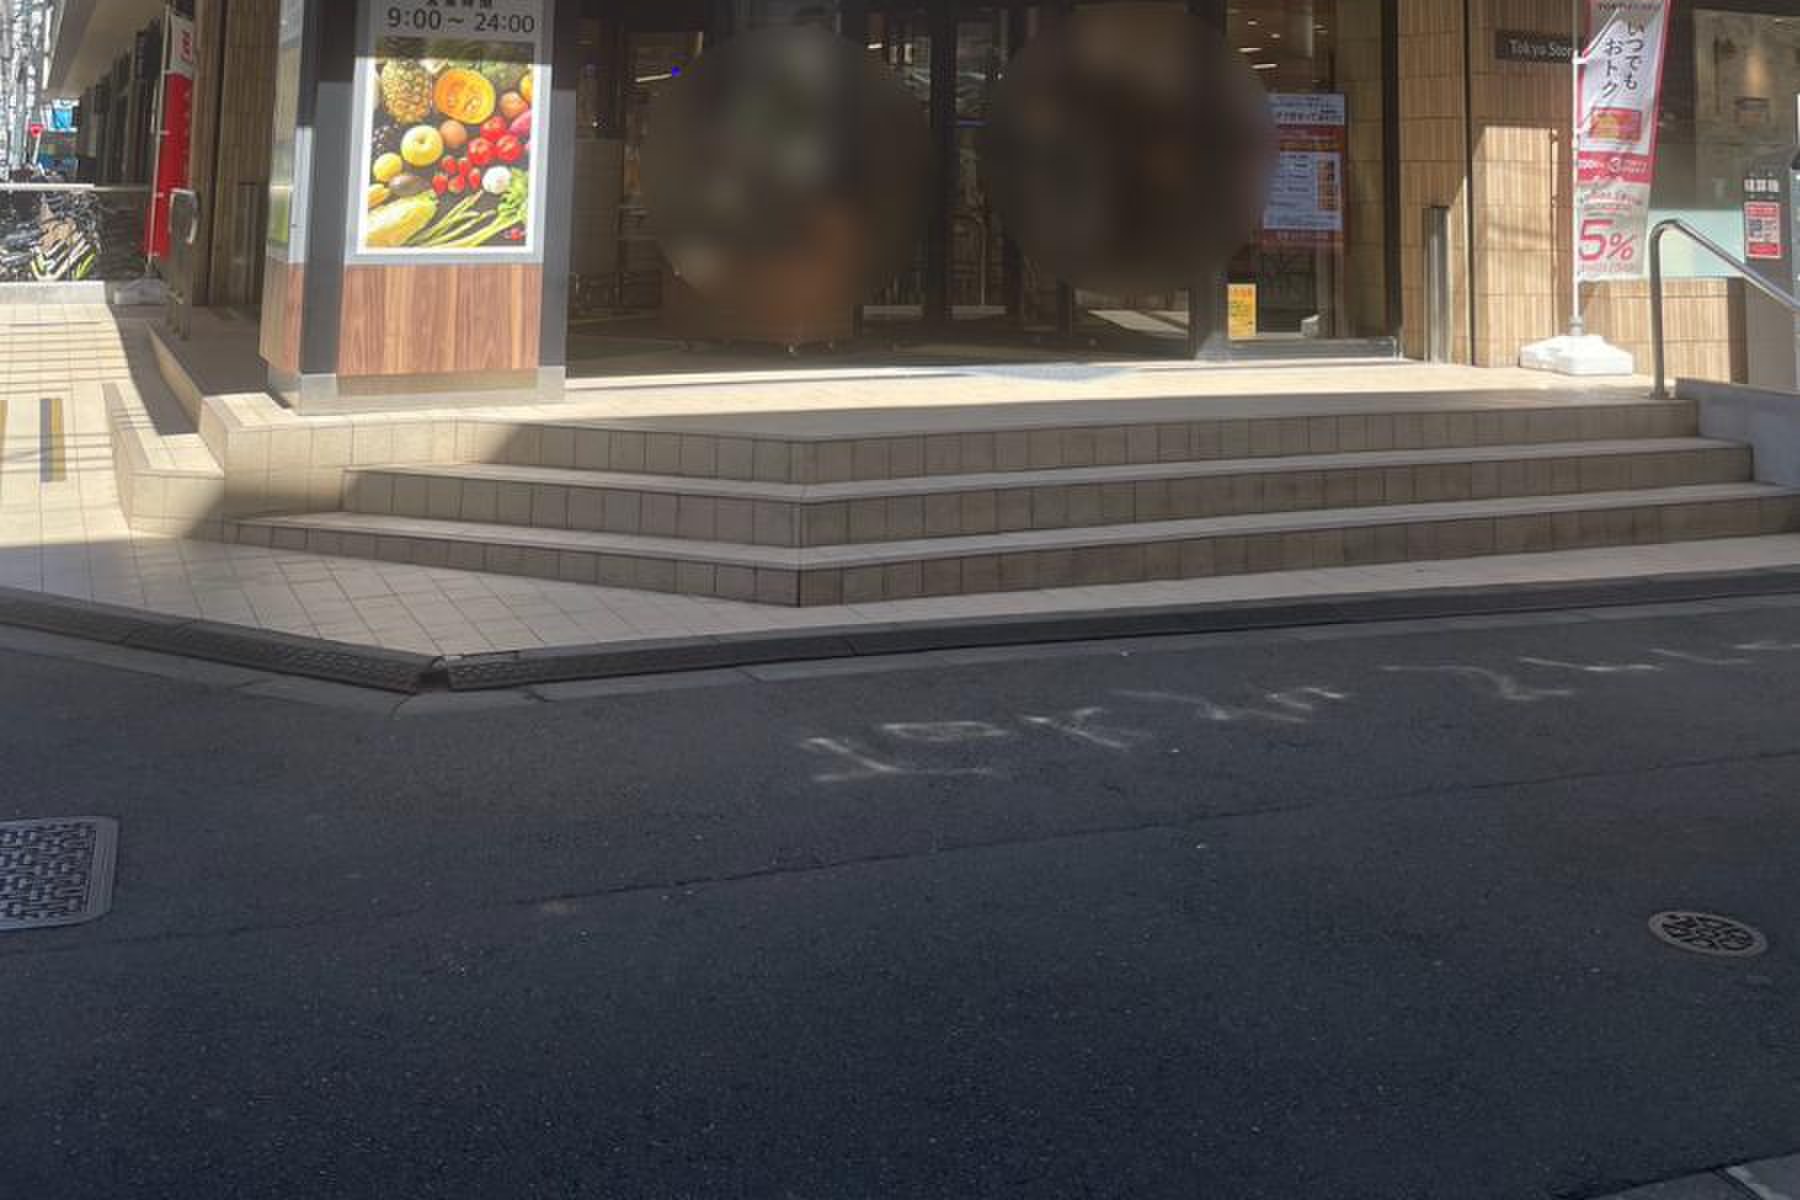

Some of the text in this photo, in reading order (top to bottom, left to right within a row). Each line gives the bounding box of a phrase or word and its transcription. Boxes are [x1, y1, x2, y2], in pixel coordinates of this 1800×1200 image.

[1602, 38, 1623, 98] おトク
[1623, 21, 1645, 90] いつでも
[1578, 218, 1633, 261] 5%
